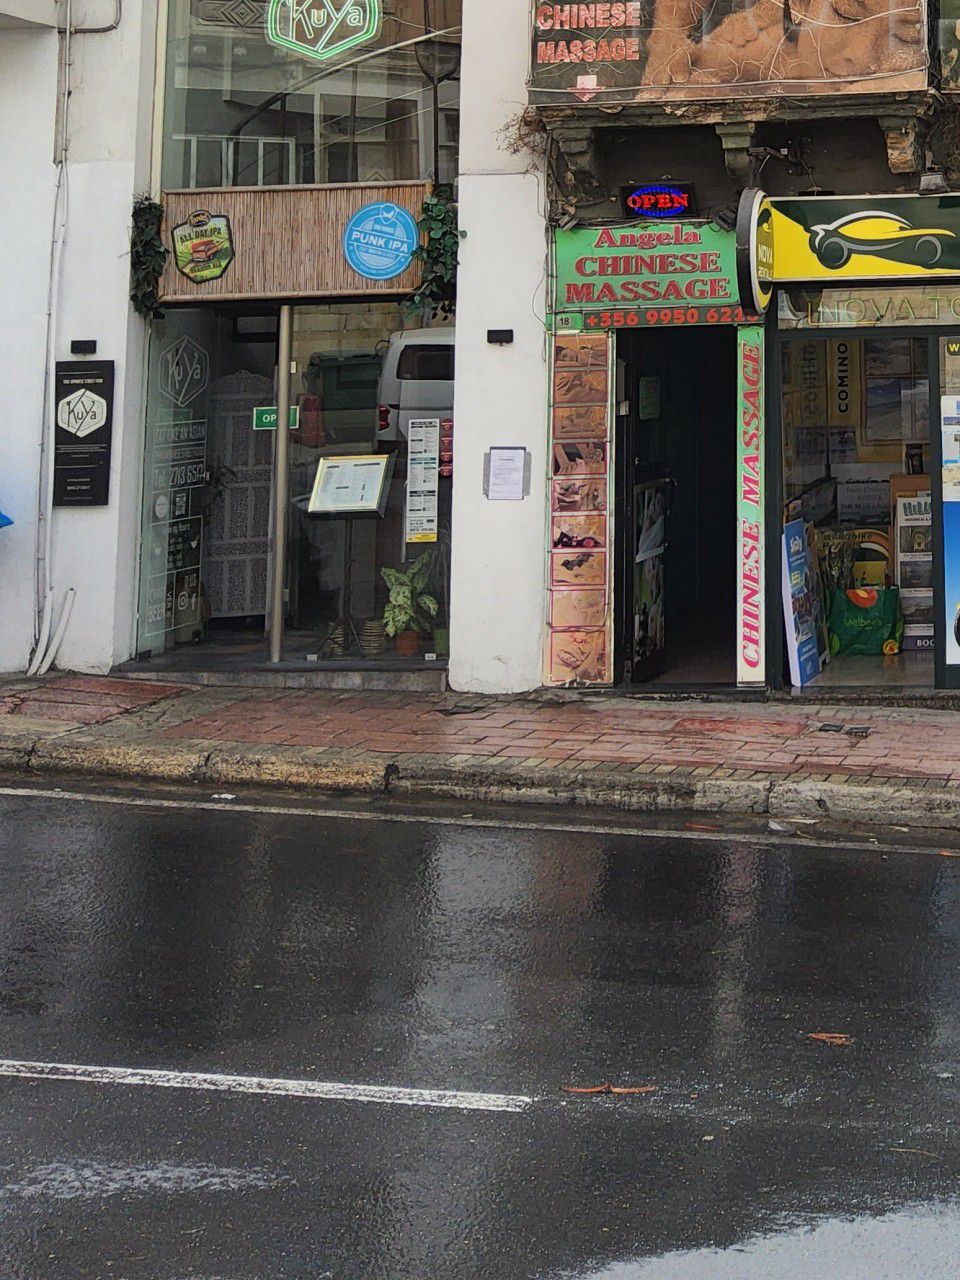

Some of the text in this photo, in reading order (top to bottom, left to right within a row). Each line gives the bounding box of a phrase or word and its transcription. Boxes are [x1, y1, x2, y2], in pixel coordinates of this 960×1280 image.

[537, 1, 640, 30] CHINESE
[537, 38, 640, 63] MASSAGE
[628, 193, 689, 209] OPEN
[352, 231, 386, 249] PUNK
[389, 240, 408, 253] IPA
[594, 224, 702, 249] Angela
[575, 252, 722, 277] CHINESE
[565, 278, 732, 304] MASSAGE
[559, 317, 570, 326] 18
[587, 307, 758, 327] +356 9950 621
[818, 296, 915, 322] NOVA
[838, 342, 849, 413] COMINO
[741, 341, 761, 669] CHINESE MASSAGE
